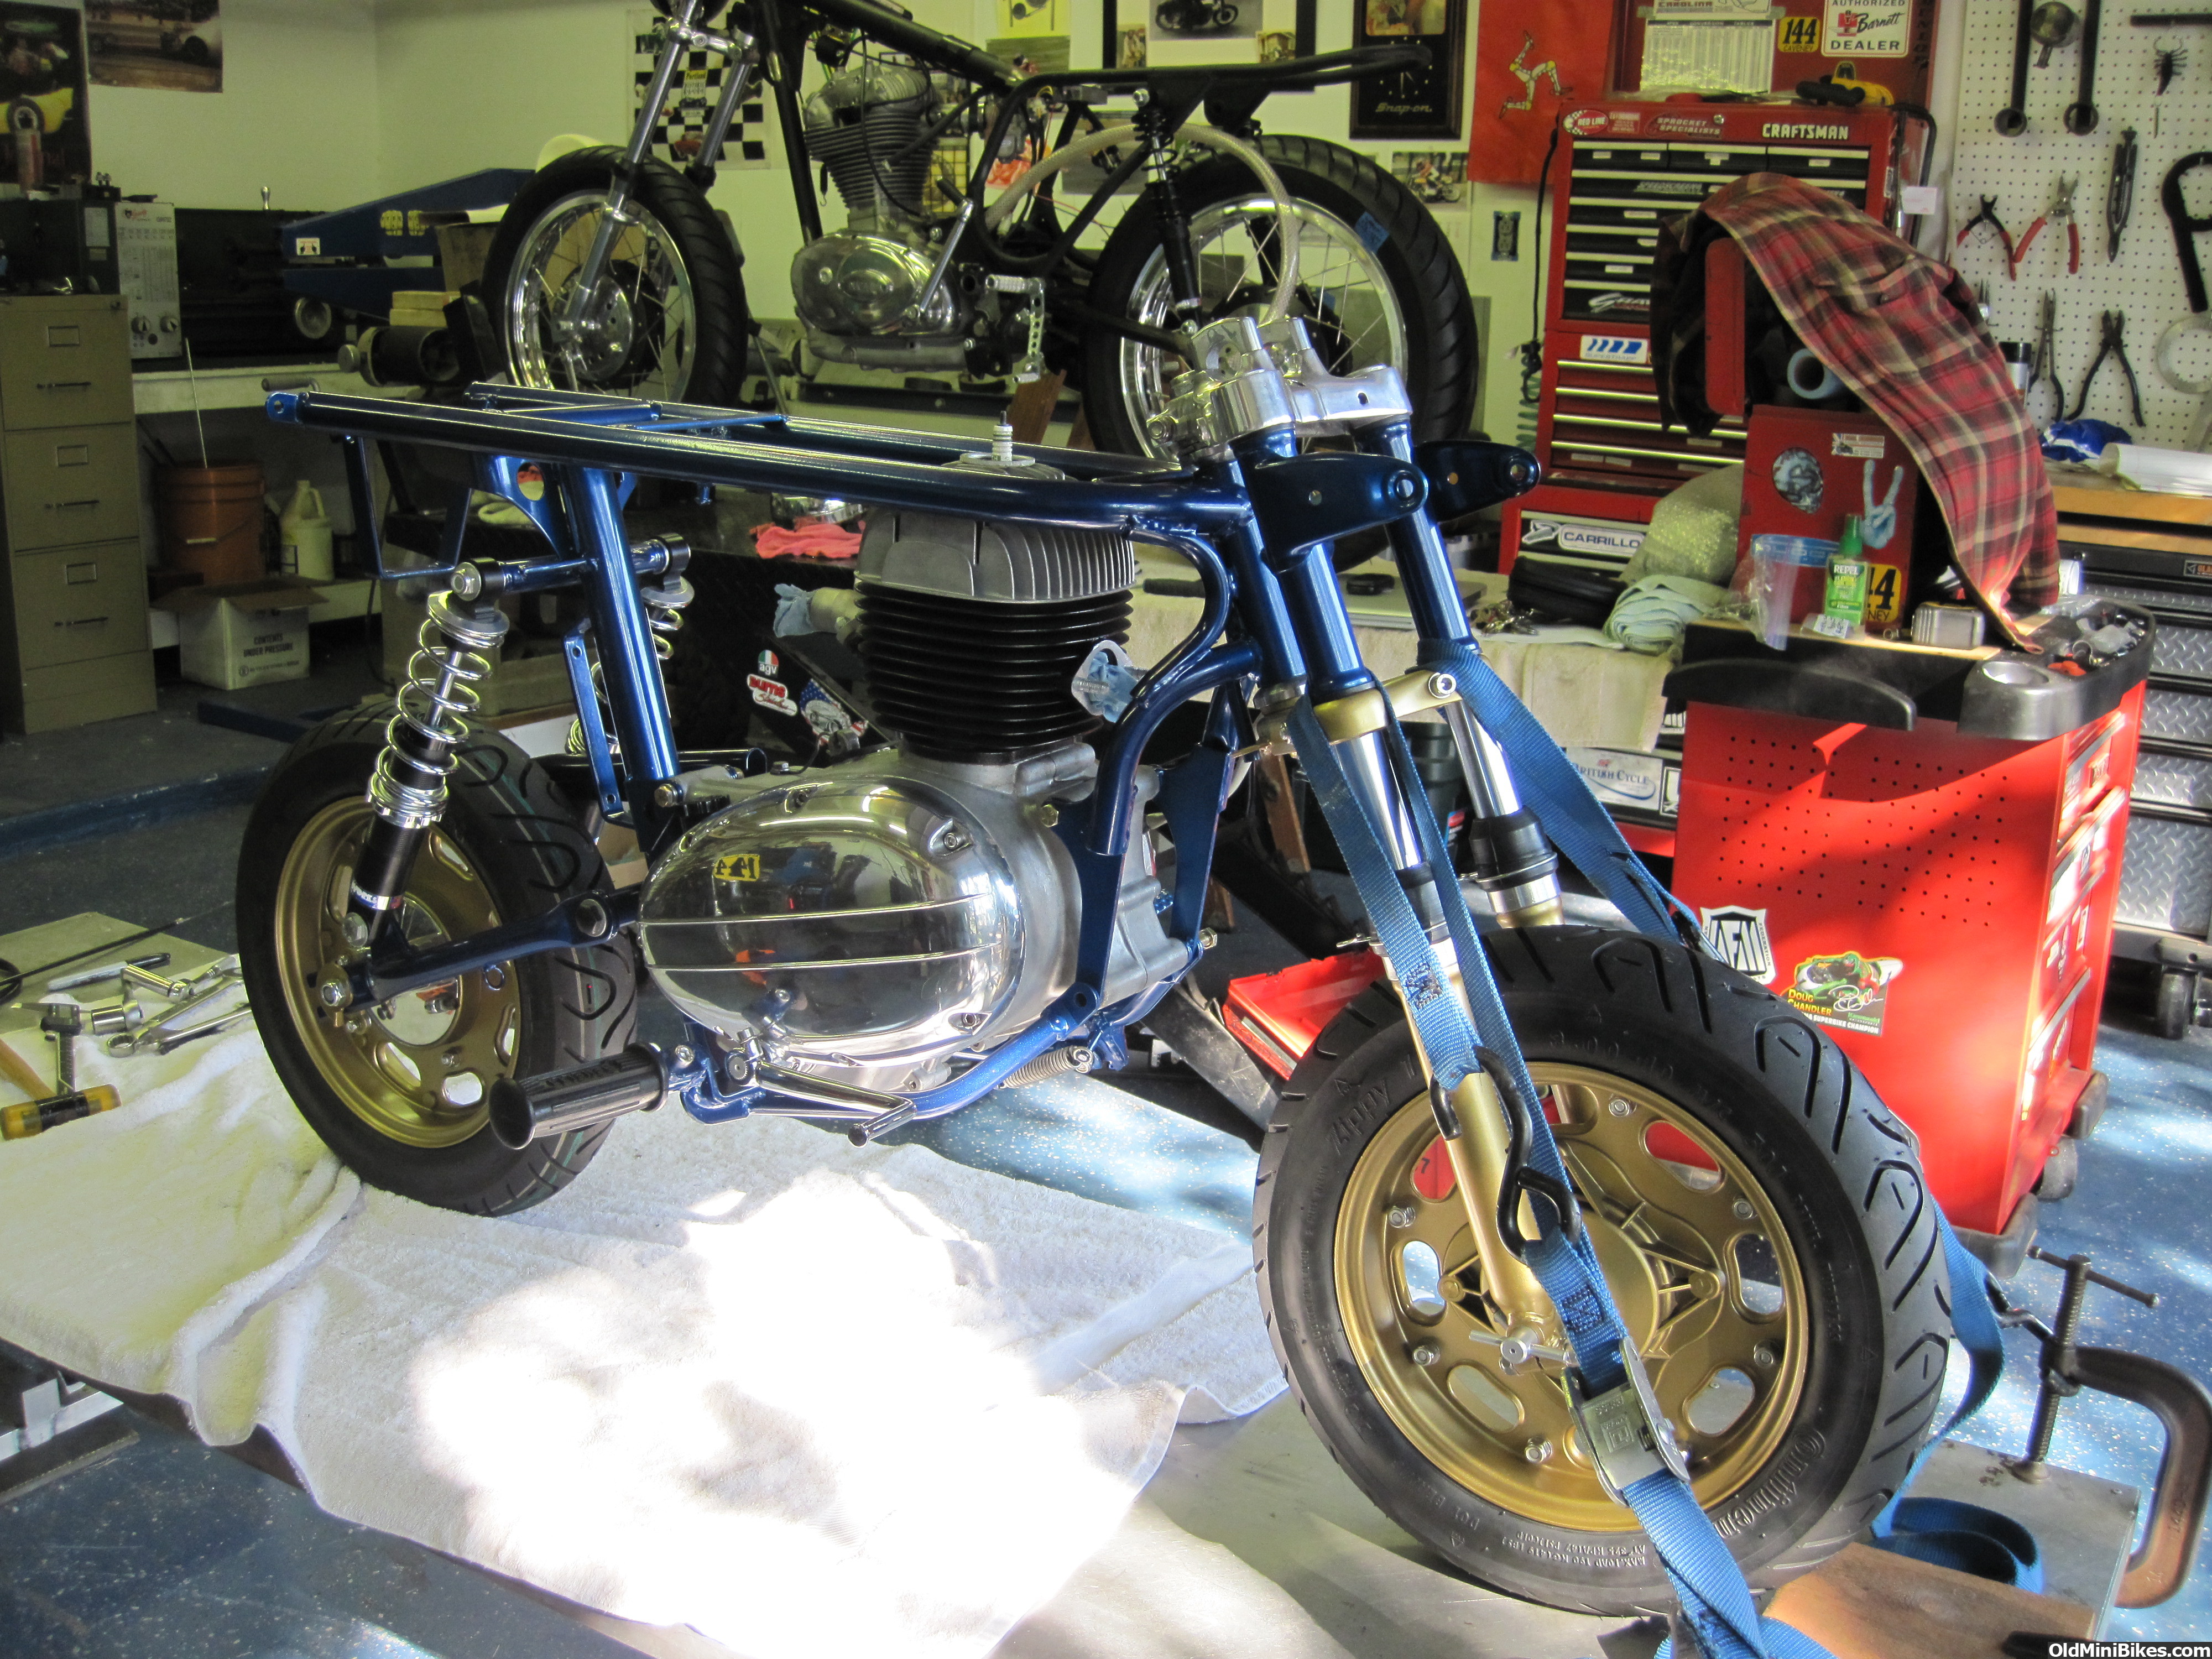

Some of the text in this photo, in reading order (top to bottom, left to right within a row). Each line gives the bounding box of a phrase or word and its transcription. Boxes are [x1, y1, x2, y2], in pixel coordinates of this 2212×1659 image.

[1855, 12, 1906, 33] Barnett
[1783, 19, 1817, 44] 144
[1830, 40, 1900, 51] DEALER
[1578, 117, 1606, 126] RED LINE
[1657, 117, 1707, 127] SPROCKET
[1659, 124, 1721, 135] SPECIALISTS
[1762, 123, 1849, 140] CRAFTSMAN
[1563, 532, 1641, 549] CARRILLO
[1834, 564, 1859, 575] REPEL
[254, 633, 283, 645] CONTENTS
[265, 642, 293, 654] PRESSURE
[759, 664, 777, 676] agv
[1759, 922, 1771, 966] FEDERATION
[1788, 988, 1814, 1003] DOUG
[1787, 998, 1832, 1016] CHANDLER
[1813, 1014, 1847, 1028] SUPERBIKE
[1847, 1021, 1879, 1035] CHAMPION
[1713, 1428, 1826, 1540] Continen
